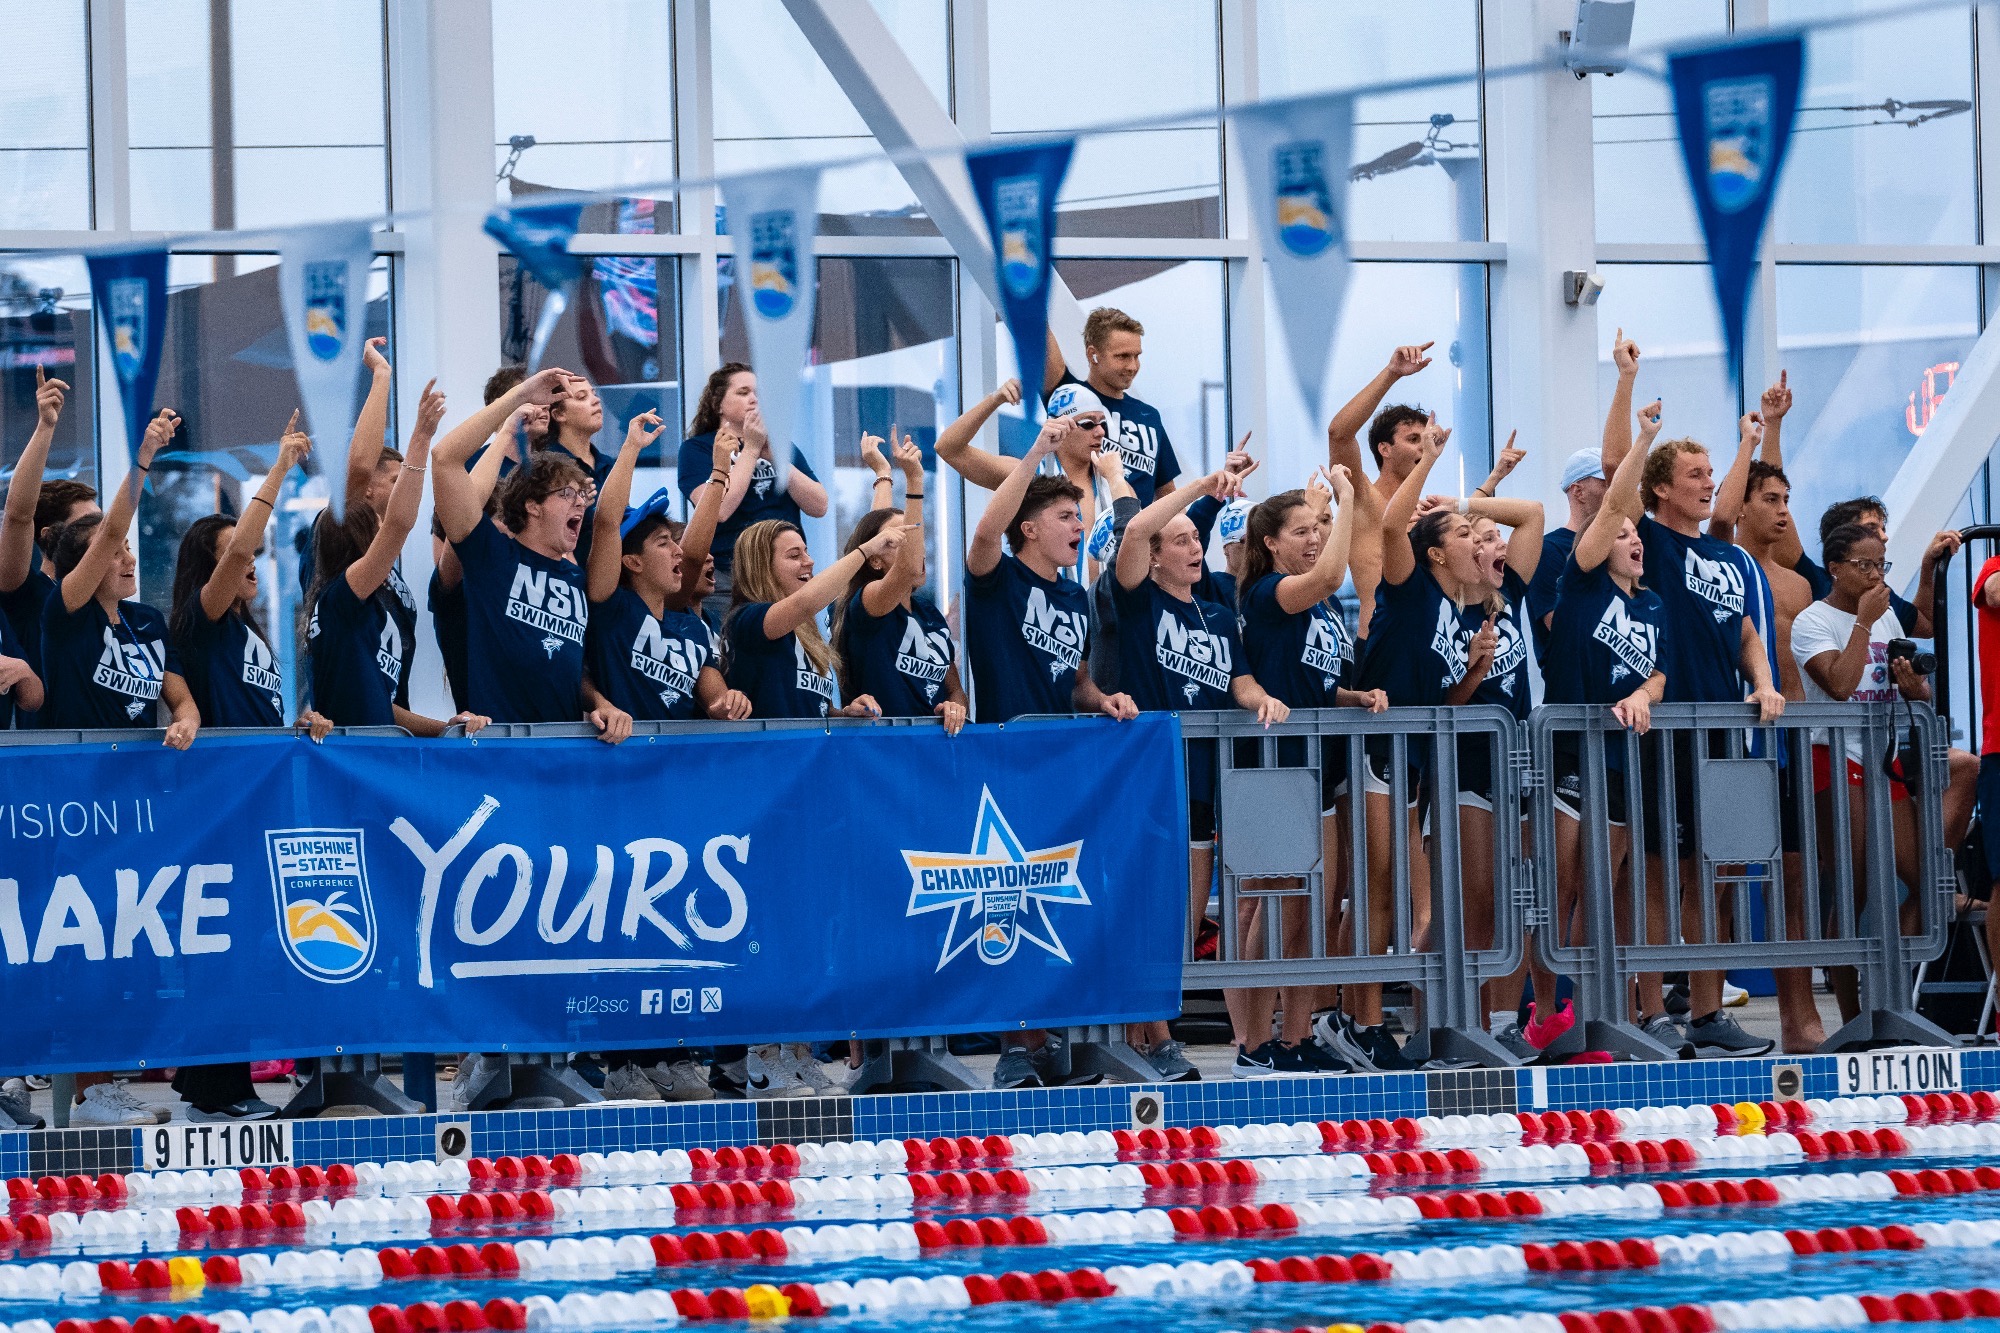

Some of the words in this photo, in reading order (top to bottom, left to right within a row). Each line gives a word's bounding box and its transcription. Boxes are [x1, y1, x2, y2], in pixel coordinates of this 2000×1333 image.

[508, 563, 589, 628] NSU
[510, 602, 585, 644] SWIMMIN
[1157, 609, 1232, 673] NSU
[97, 667, 162, 698] SWIMMIN
[0, 801, 118, 839] ISION
[135, 799, 154, 833] II
[279, 841, 355, 856] SUNSHINE
[298, 857, 344, 871] STATE
[290, 879, 354, 889] CONFERENCE
[920, 861, 1069, 892] CHAMPIONSHIP
[986, 894, 1018, 904] SUNSHINE
[992, 903, 1011, 911] STATE
[565, 995, 630, 1014] #d2ssc
[1847, 1056, 1860, 1092] 9
[155, 1128, 171, 1169] 9
